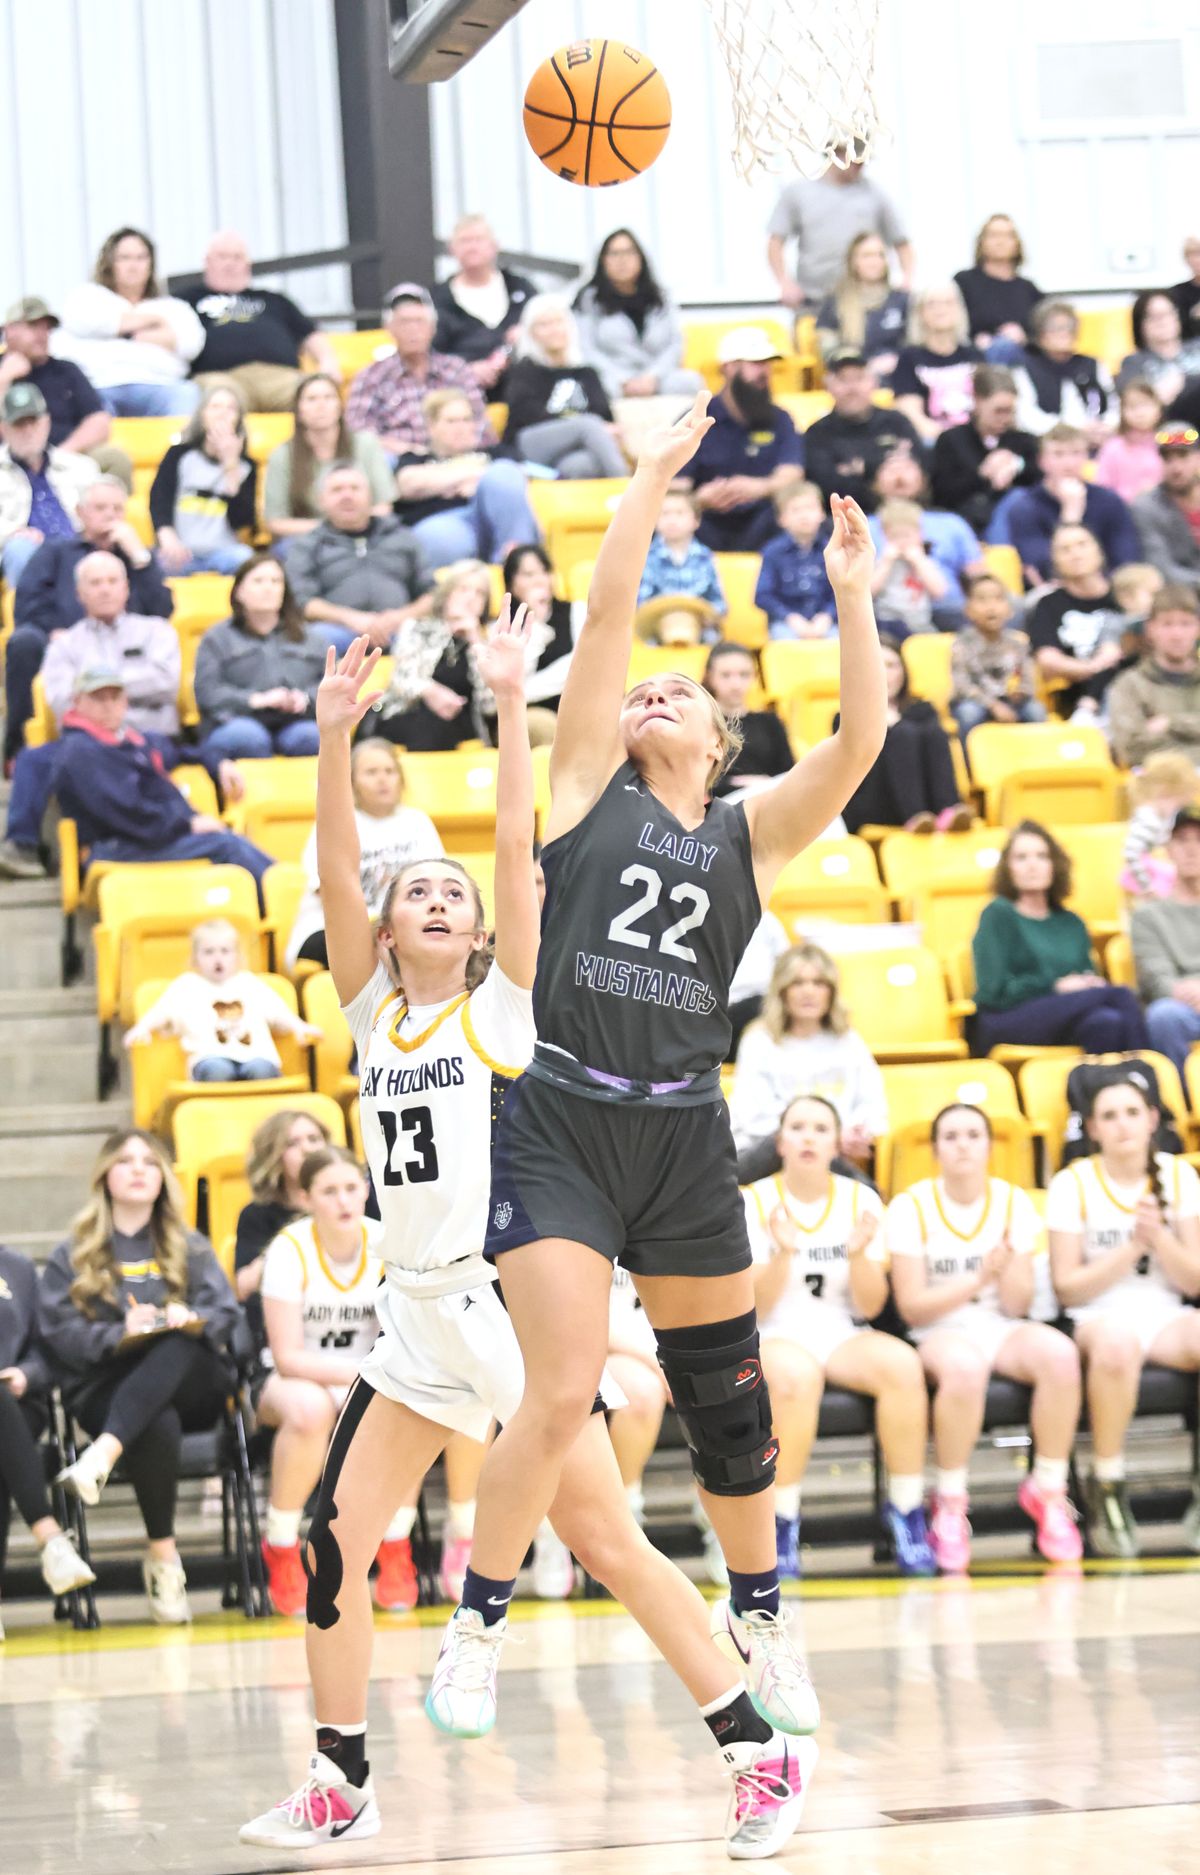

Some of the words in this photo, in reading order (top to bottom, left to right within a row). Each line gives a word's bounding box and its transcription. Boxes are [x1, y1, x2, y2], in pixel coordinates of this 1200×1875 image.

[638, 822, 719, 872] LADY
[607, 863, 711, 964] 22
[575, 951, 717, 1016] MUSTANGS
[387, 1056, 465, 1097] HOUNDS
